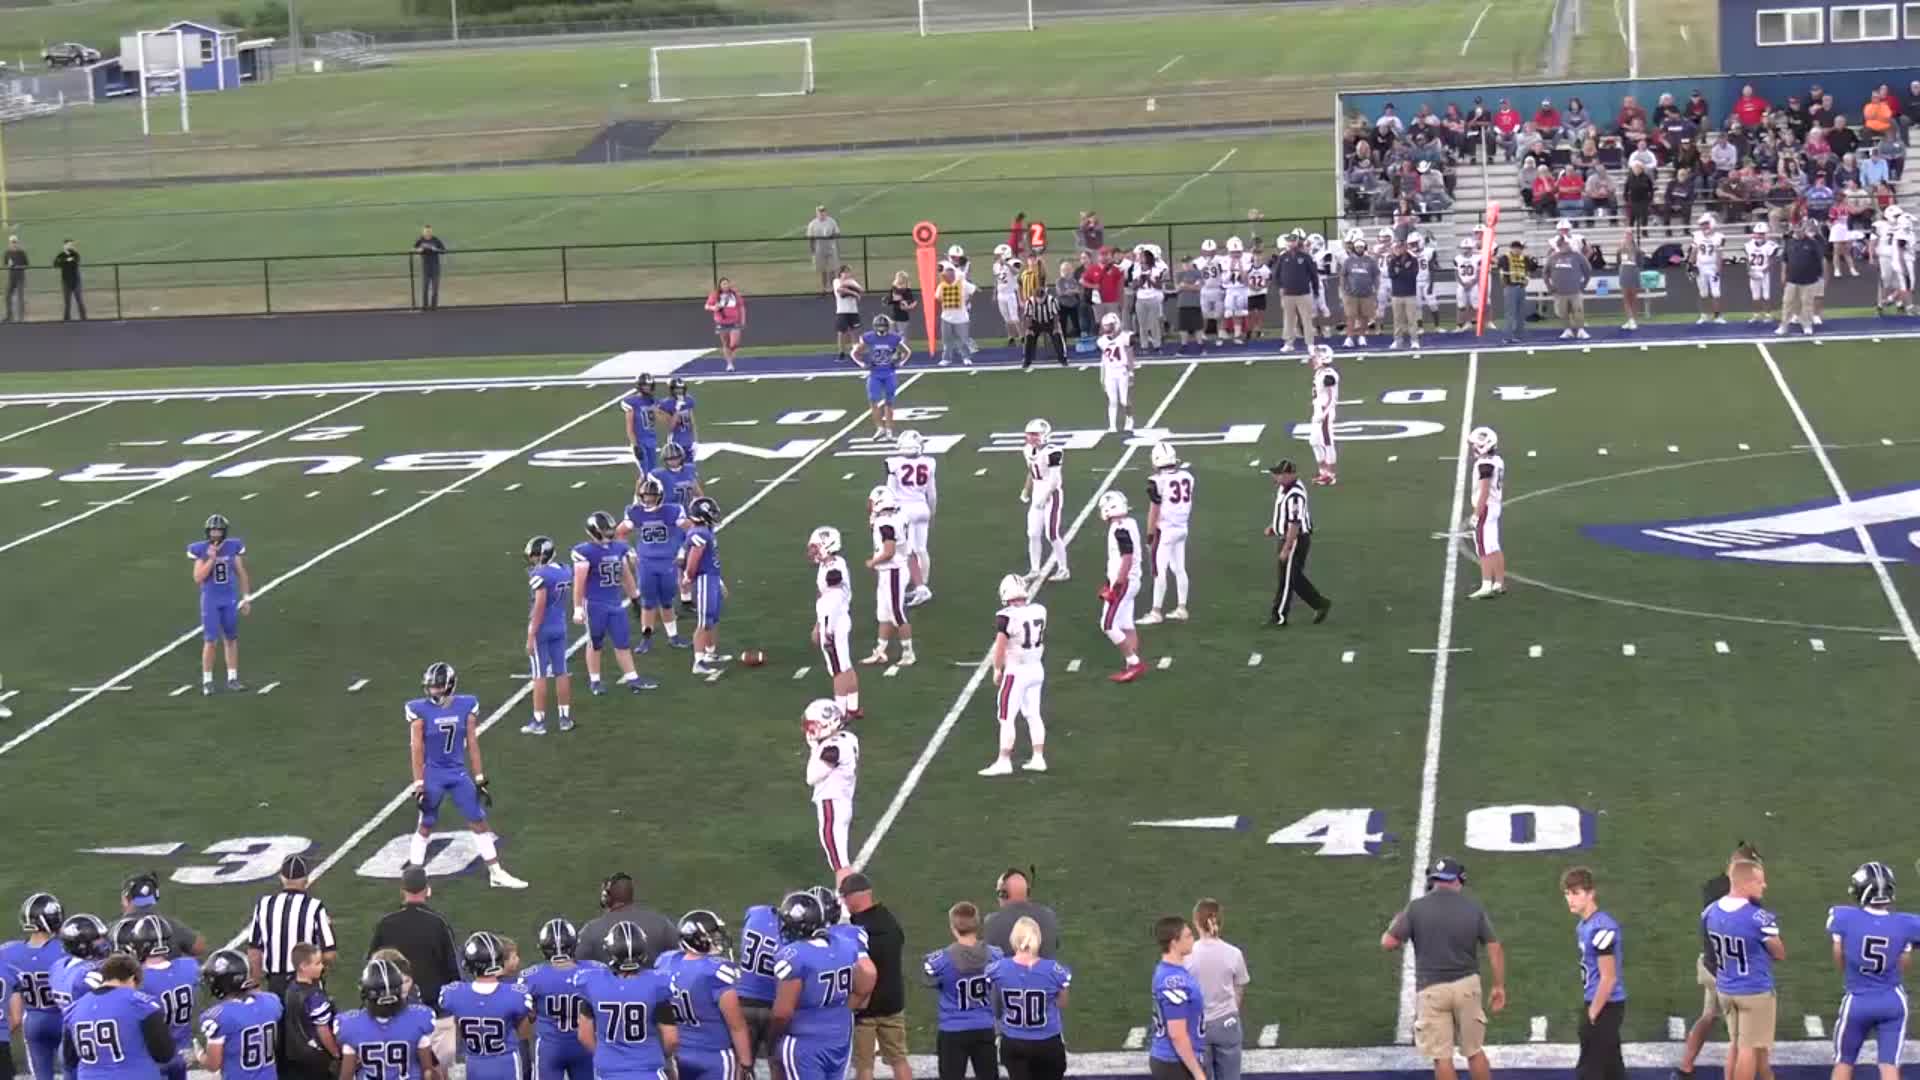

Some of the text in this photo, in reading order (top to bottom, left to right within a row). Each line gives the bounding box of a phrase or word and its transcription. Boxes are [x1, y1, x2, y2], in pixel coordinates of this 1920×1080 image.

[1030, 223, 1045, 246] 2
[900, 463, 928, 487] 26
[1169, 478, 1192, 504] 33
[213, 561, 229, 584] 8
[1021, 619, 1046, 649] 17
[439, 722, 456, 754] 7
[1859, 936, 1889, 977] 5
[161, 984, 193, 1025] 18
[818, 966, 853, 1009] 79
[599, 1001, 648, 1044] 78
[1003, 988, 1047, 1028] 50
[75, 1019, 125, 1065] 69
[358, 1040, 410, 1080] 59
